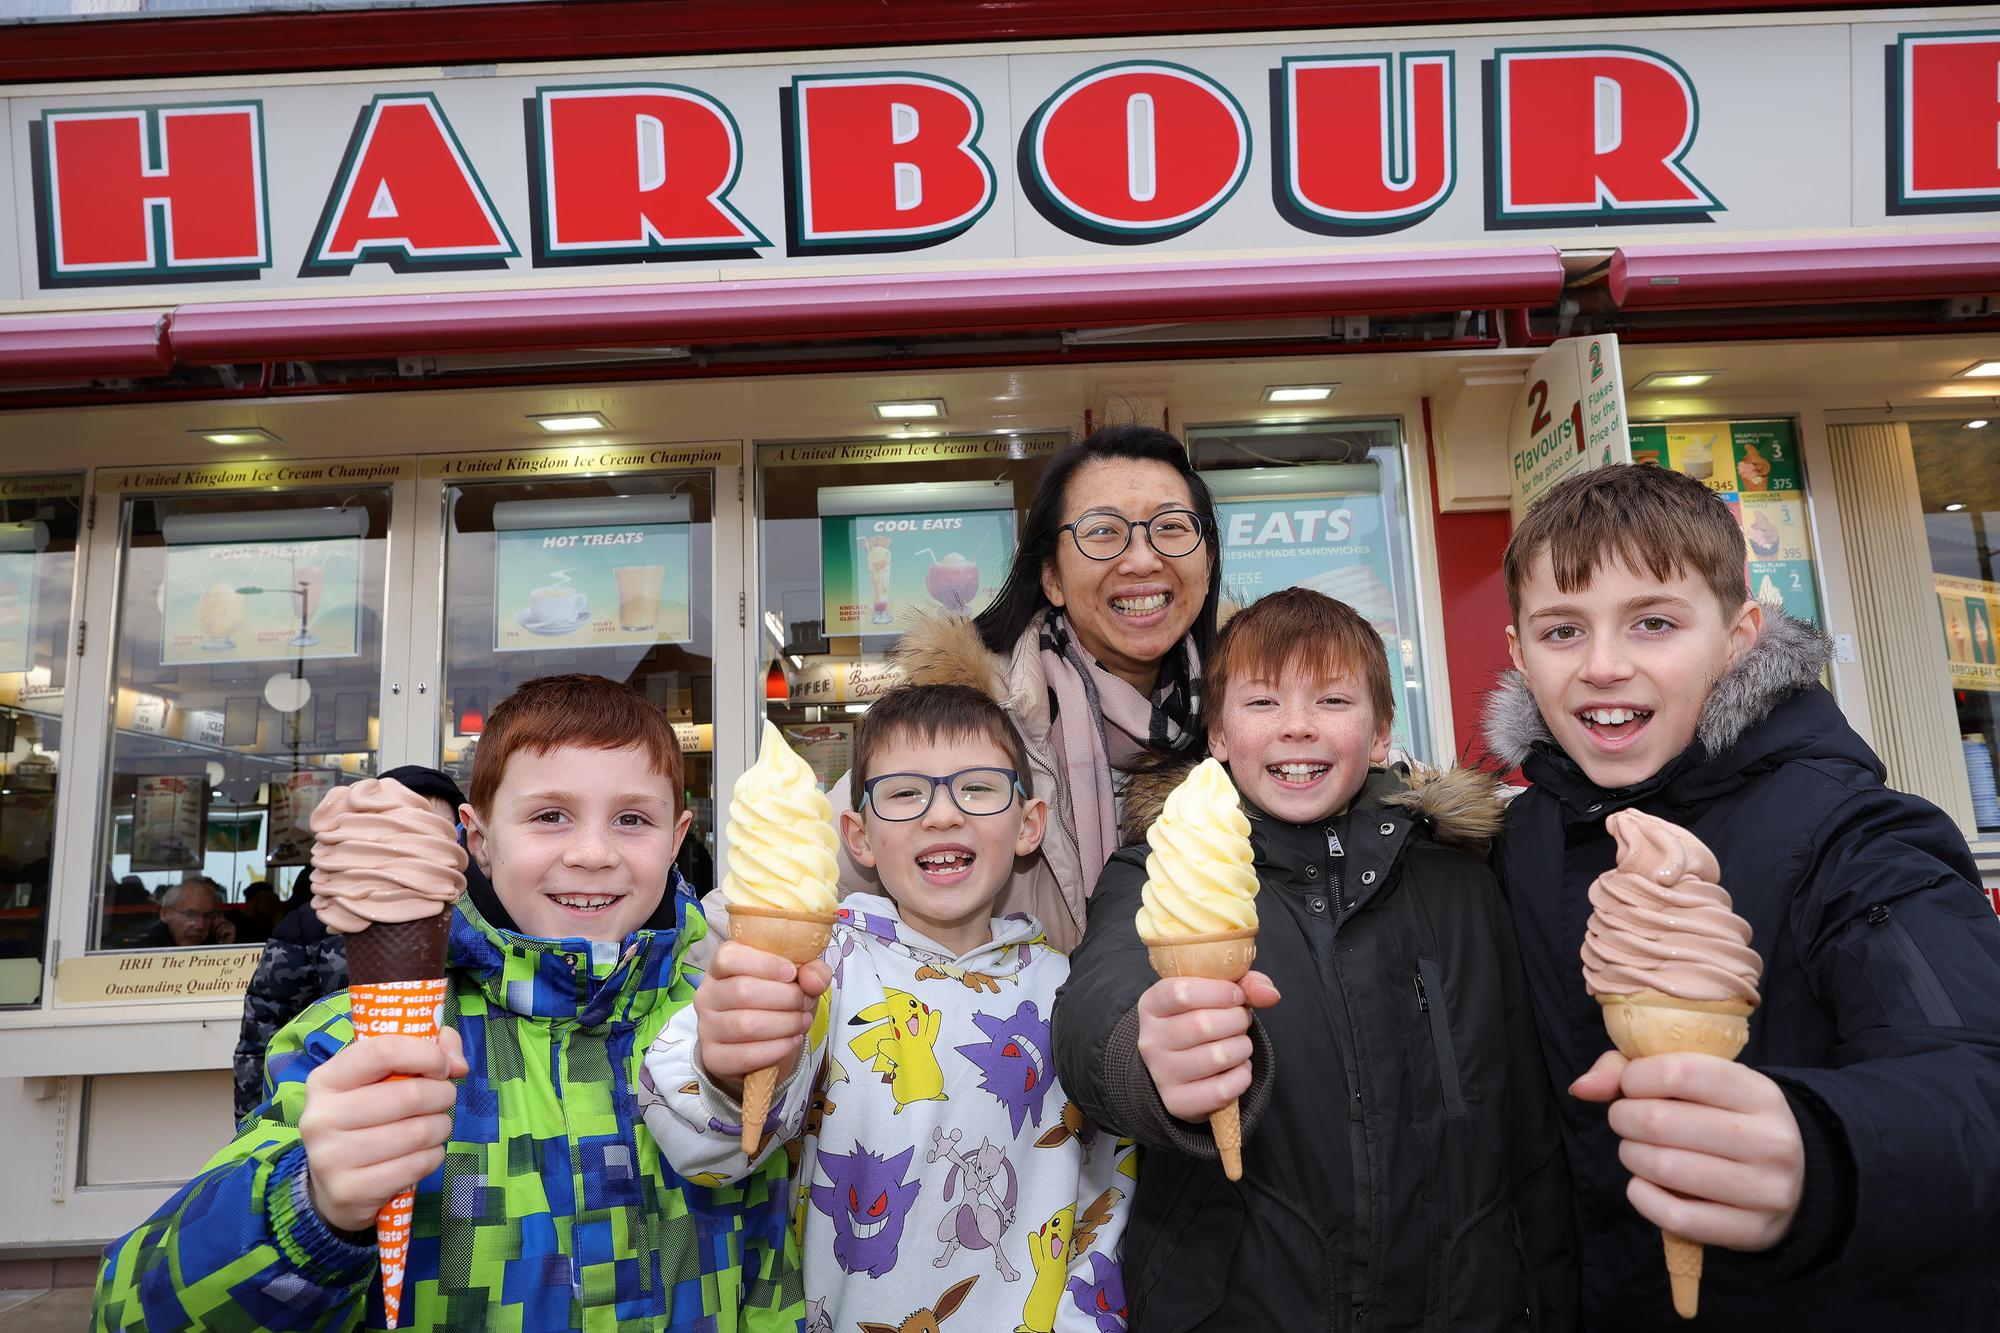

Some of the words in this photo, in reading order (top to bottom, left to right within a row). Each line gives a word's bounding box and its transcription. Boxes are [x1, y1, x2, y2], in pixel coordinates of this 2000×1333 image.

[32, 46, 1725, 288] HARBOUR
[1588, 341, 1604, 384] 2
[1588, 381, 1614, 408] Flakes
[1527, 379, 1551, 439] 2
[1590, 411, 1601, 427] for
[1602, 400, 1616, 417] the
[1570, 399, 1586, 455] 1
[1589, 425, 1609, 448] Price
[1610, 415, 1619, 432] of
[774, 451, 785, 461] A
[790, 447, 835, 460] United
[840, 445, 902, 461] Kingdom
[907, 443, 928, 456] Ice
[933, 442, 978, 455] Cream
[1513, 418, 1572, 480] Flavours
[1772, 444, 1783, 458] 3
[440, 462, 451, 473] A
[456, 459, 501, 473] United
[506, 457, 568, 473] Kingdom
[573, 455, 595, 468] Ice
[599, 453, 645, 466] Cream
[650, 450, 722, 466] Champion
[1522, 480, 1533, 495] for
[1532, 470, 1544, 486] the
[1544, 456, 1564, 479] price
[1564, 444, 1573, 461] of
[118, 476, 130, 488] A
[134, 472, 180, 487] United
[184, 470, 247, 487] Kingdom
[252, 469, 273, 481] Ice
[278, 466, 323, 480] Cream
[328, 463, 401, 480] Champion
[1773, 478, 1793, 489] 375
[1, 480, 73, 499] Champion
[1781, 508, 1791, 523] 3
[873, 518, 919, 533] COOL
[922, 517, 963, 532] EATS
[1226, 508, 1352, 546] EATS
[542, 534, 577, 549] HOT
[582, 531, 644, 547] TREATS
[257, 544, 320, 558] TREATS
[1223, 550, 1263, 561] RESHLY
[1266, 549, 1296, 558] MADE
[1299, 545, 1370, 556] SANDWICHES
[1783, 548, 1802, 559] 395
[1223, 571, 1263, 585] EESE
[1789, 573, 1802, 588] 2
[788, 679, 831, 698] OFFEE
[119, 957, 153, 971] HRH
[162, 956, 185, 969] The
[188, 954, 230, 968] Prince
[233, 953, 249, 968] of
[220, 967, 234, 977] for
[105, 979, 183, 996] Outstanding
[186, 977, 233, 995] Quality
[236, 977, 249, 989] in
[375, 994, 402, 1003] amor
[402, 994, 434, 1005] gelato
[367, 1007, 403, 1017] cream
[402, 1021, 434, 1033] amor
[379, 1246, 401, 1259] ove
